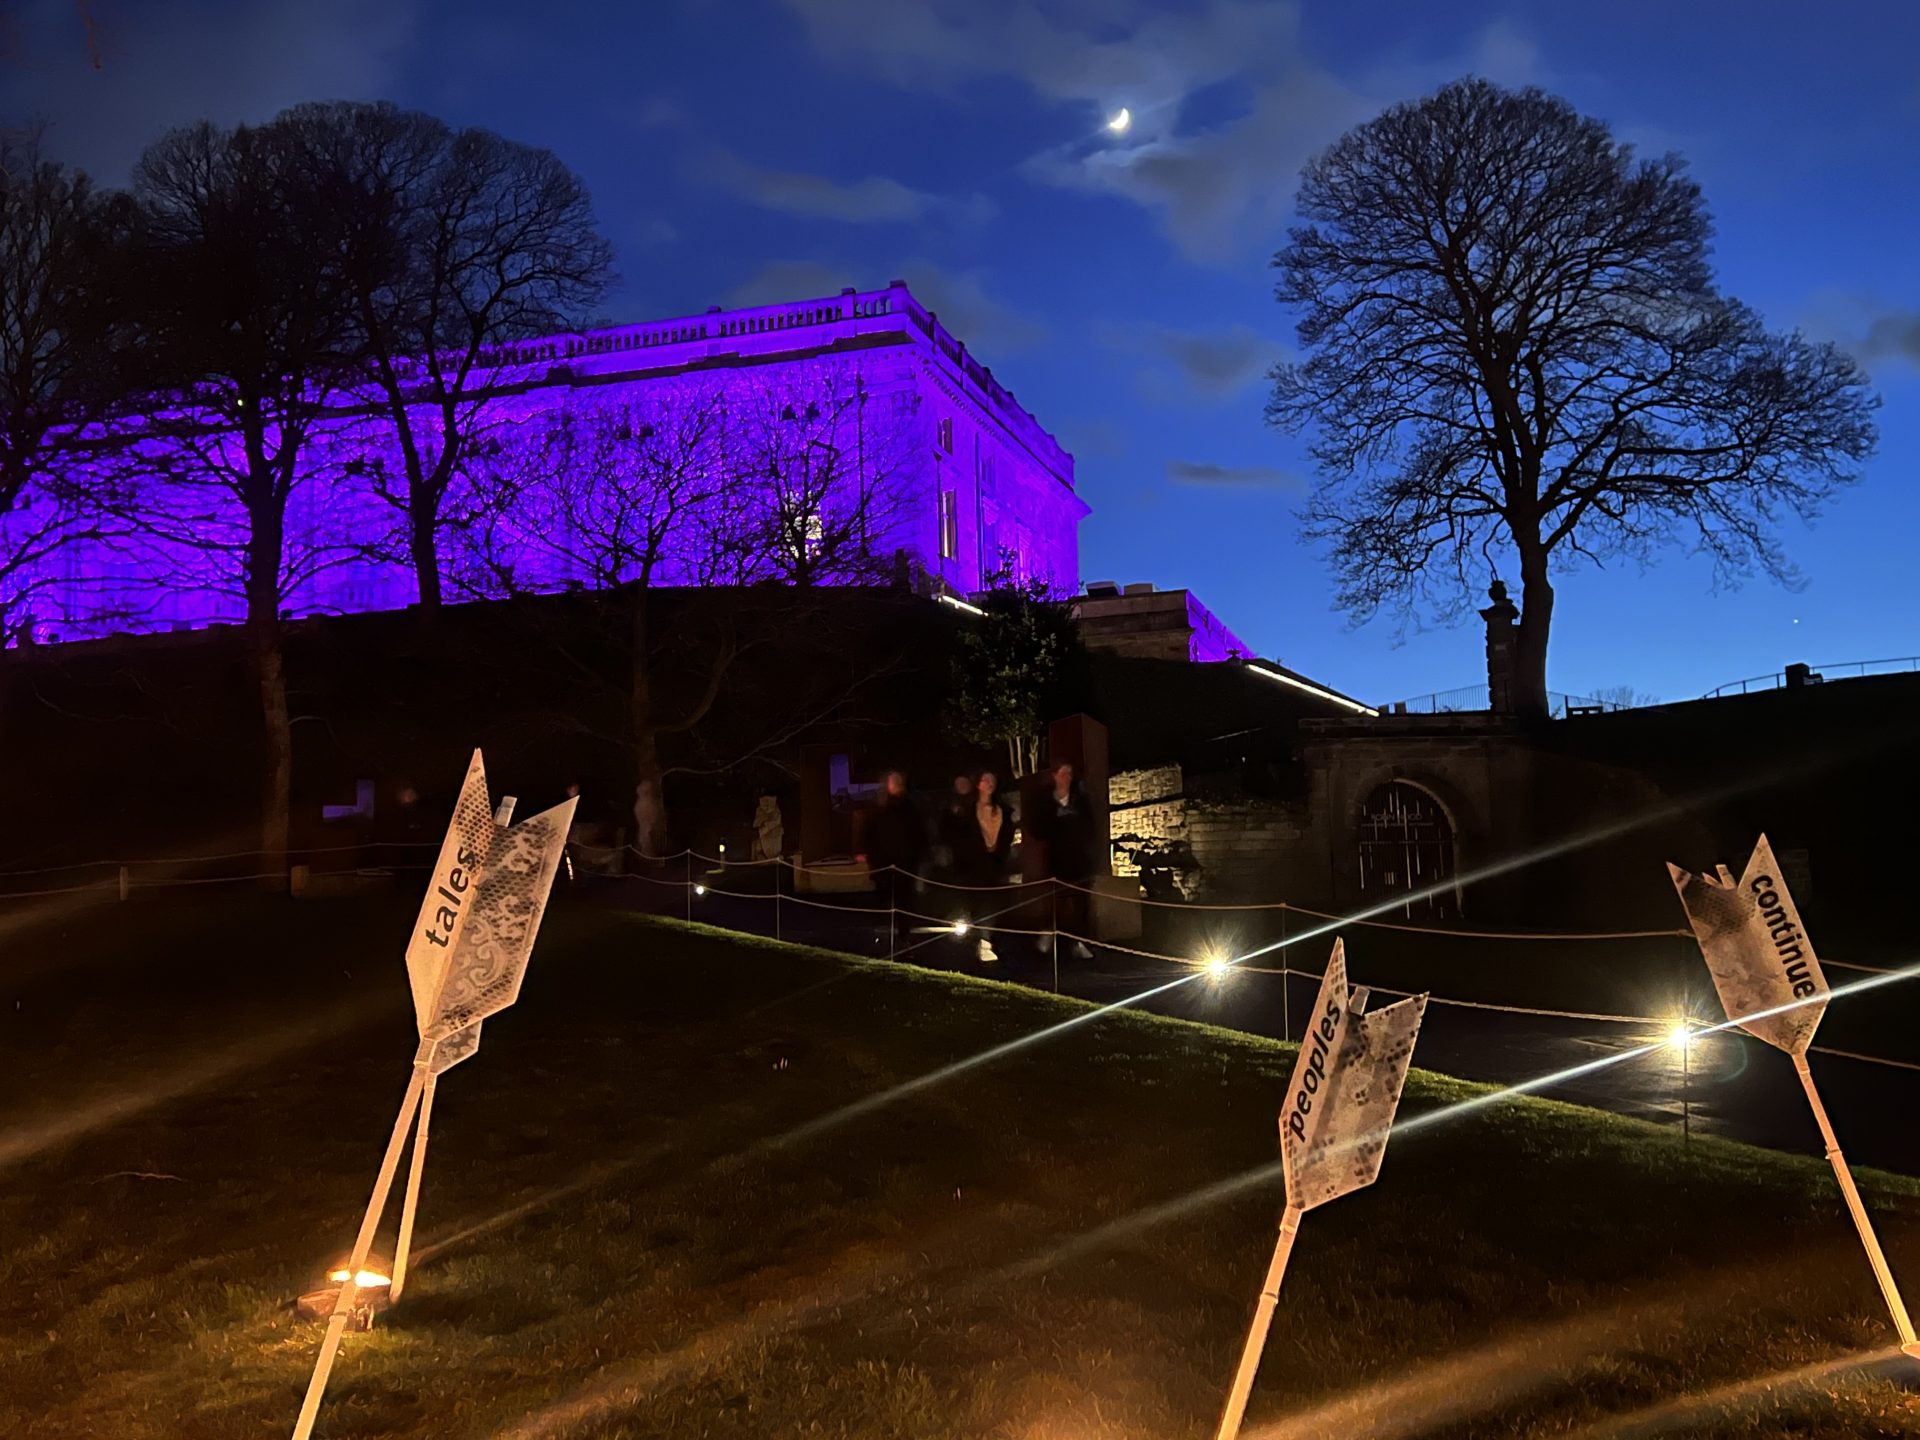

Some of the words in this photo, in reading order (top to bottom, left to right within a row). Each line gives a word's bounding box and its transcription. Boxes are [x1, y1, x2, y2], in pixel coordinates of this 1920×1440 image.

[425, 845, 476, 948] tales
[1751, 875, 1816, 999] continue
[1289, 1000, 1341, 1142] peoples
